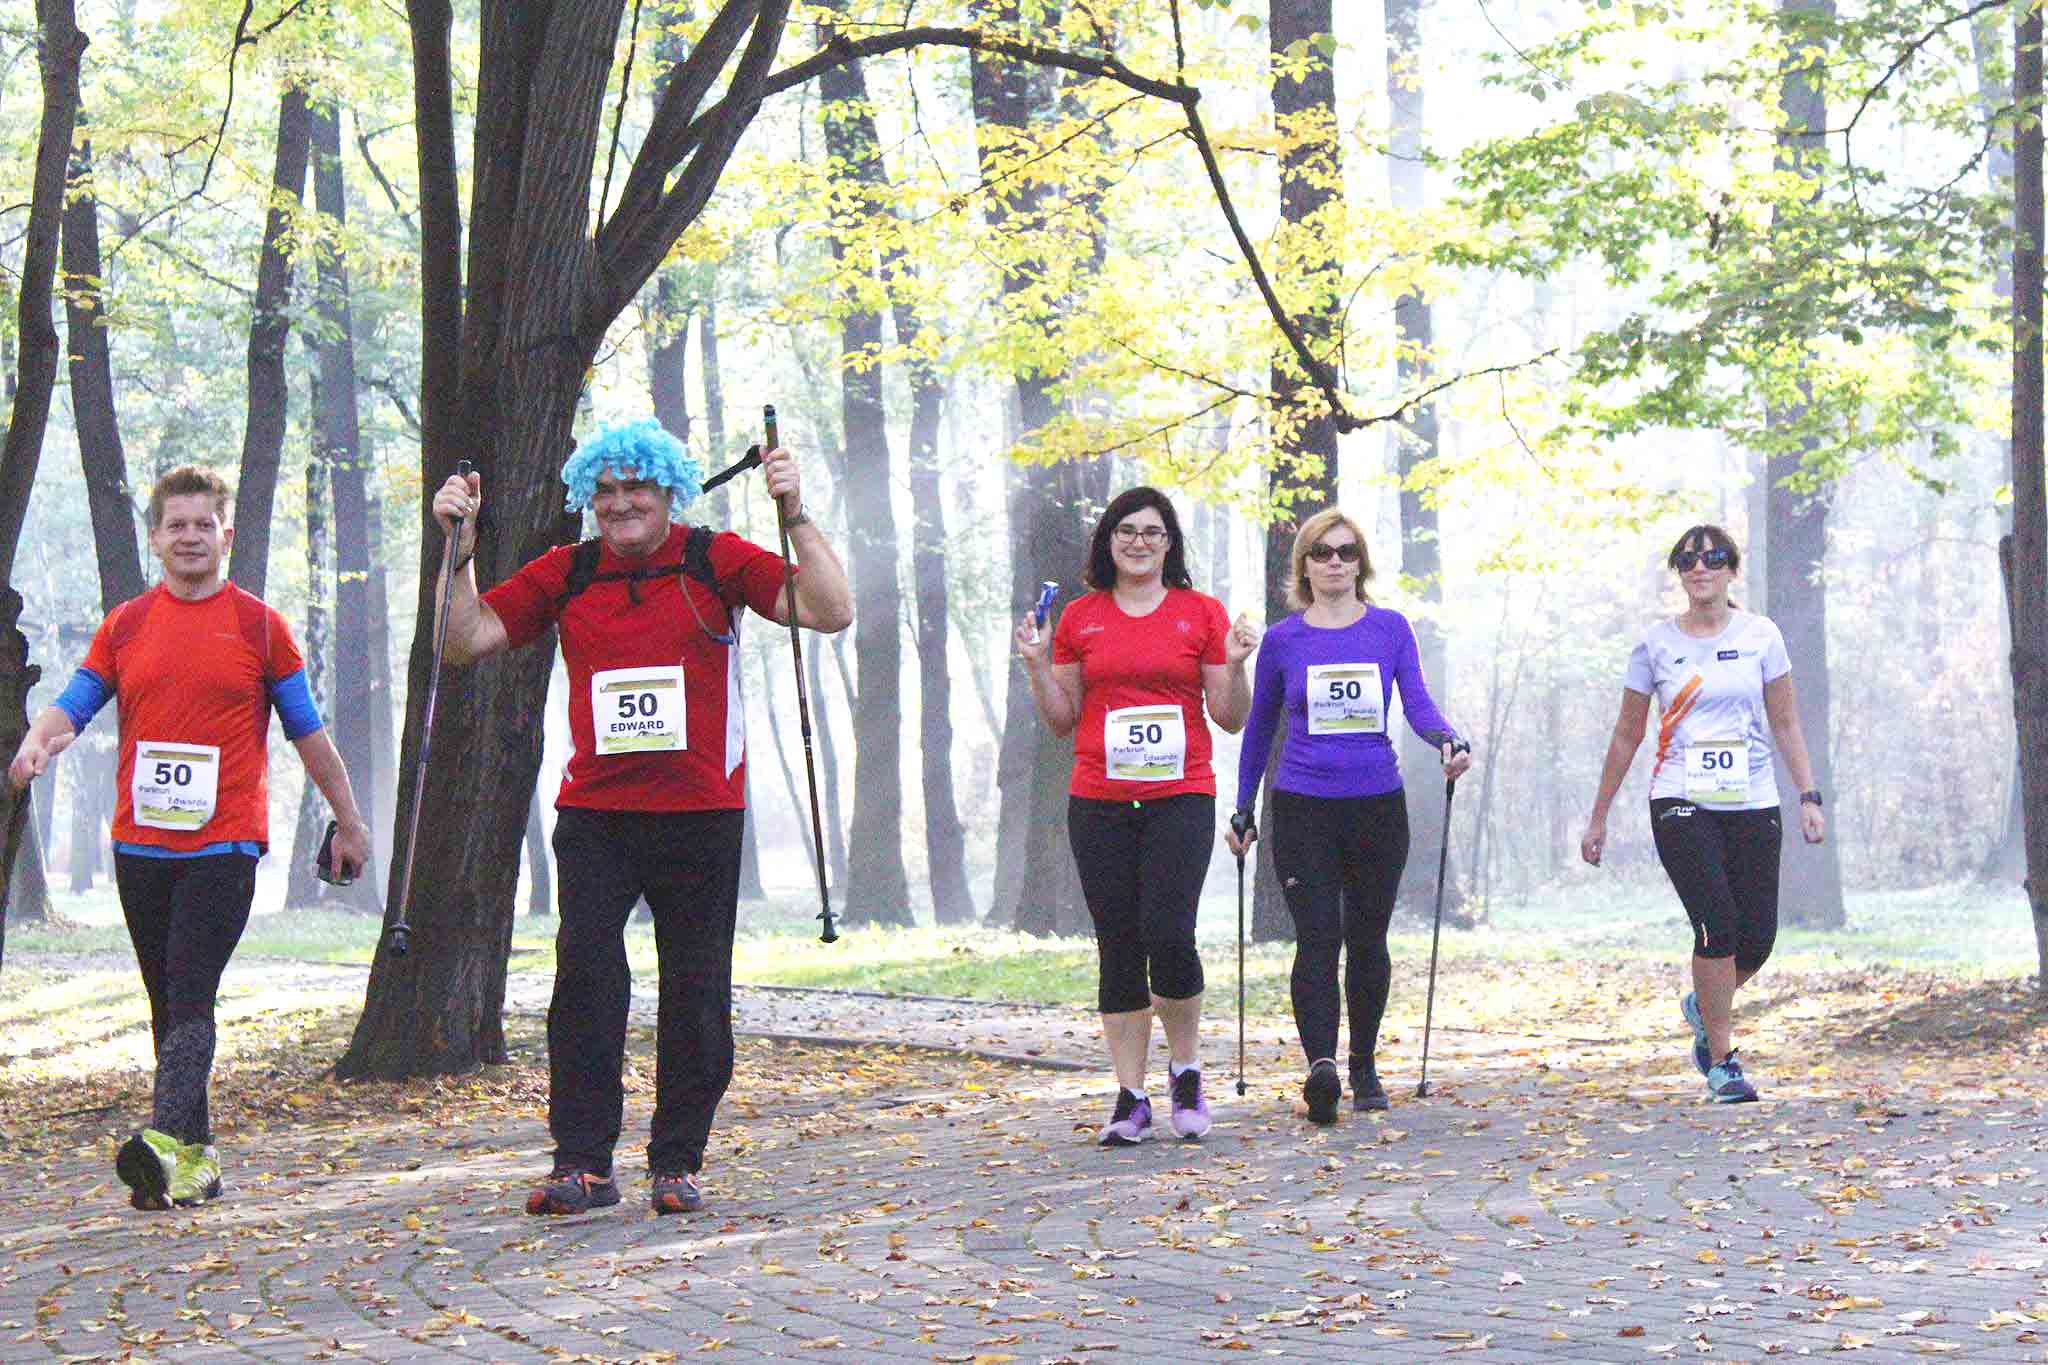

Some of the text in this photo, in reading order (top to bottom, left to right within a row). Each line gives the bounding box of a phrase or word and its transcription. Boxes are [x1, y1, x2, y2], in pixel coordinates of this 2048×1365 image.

[1329, 681, 1362, 700] 50
[618, 693, 657, 718] 50
[610, 720, 664, 732] EDWARD
[1129, 723, 1162, 745] 50
[1702, 750, 1733, 770] 50
[154, 762, 192, 786] 50
